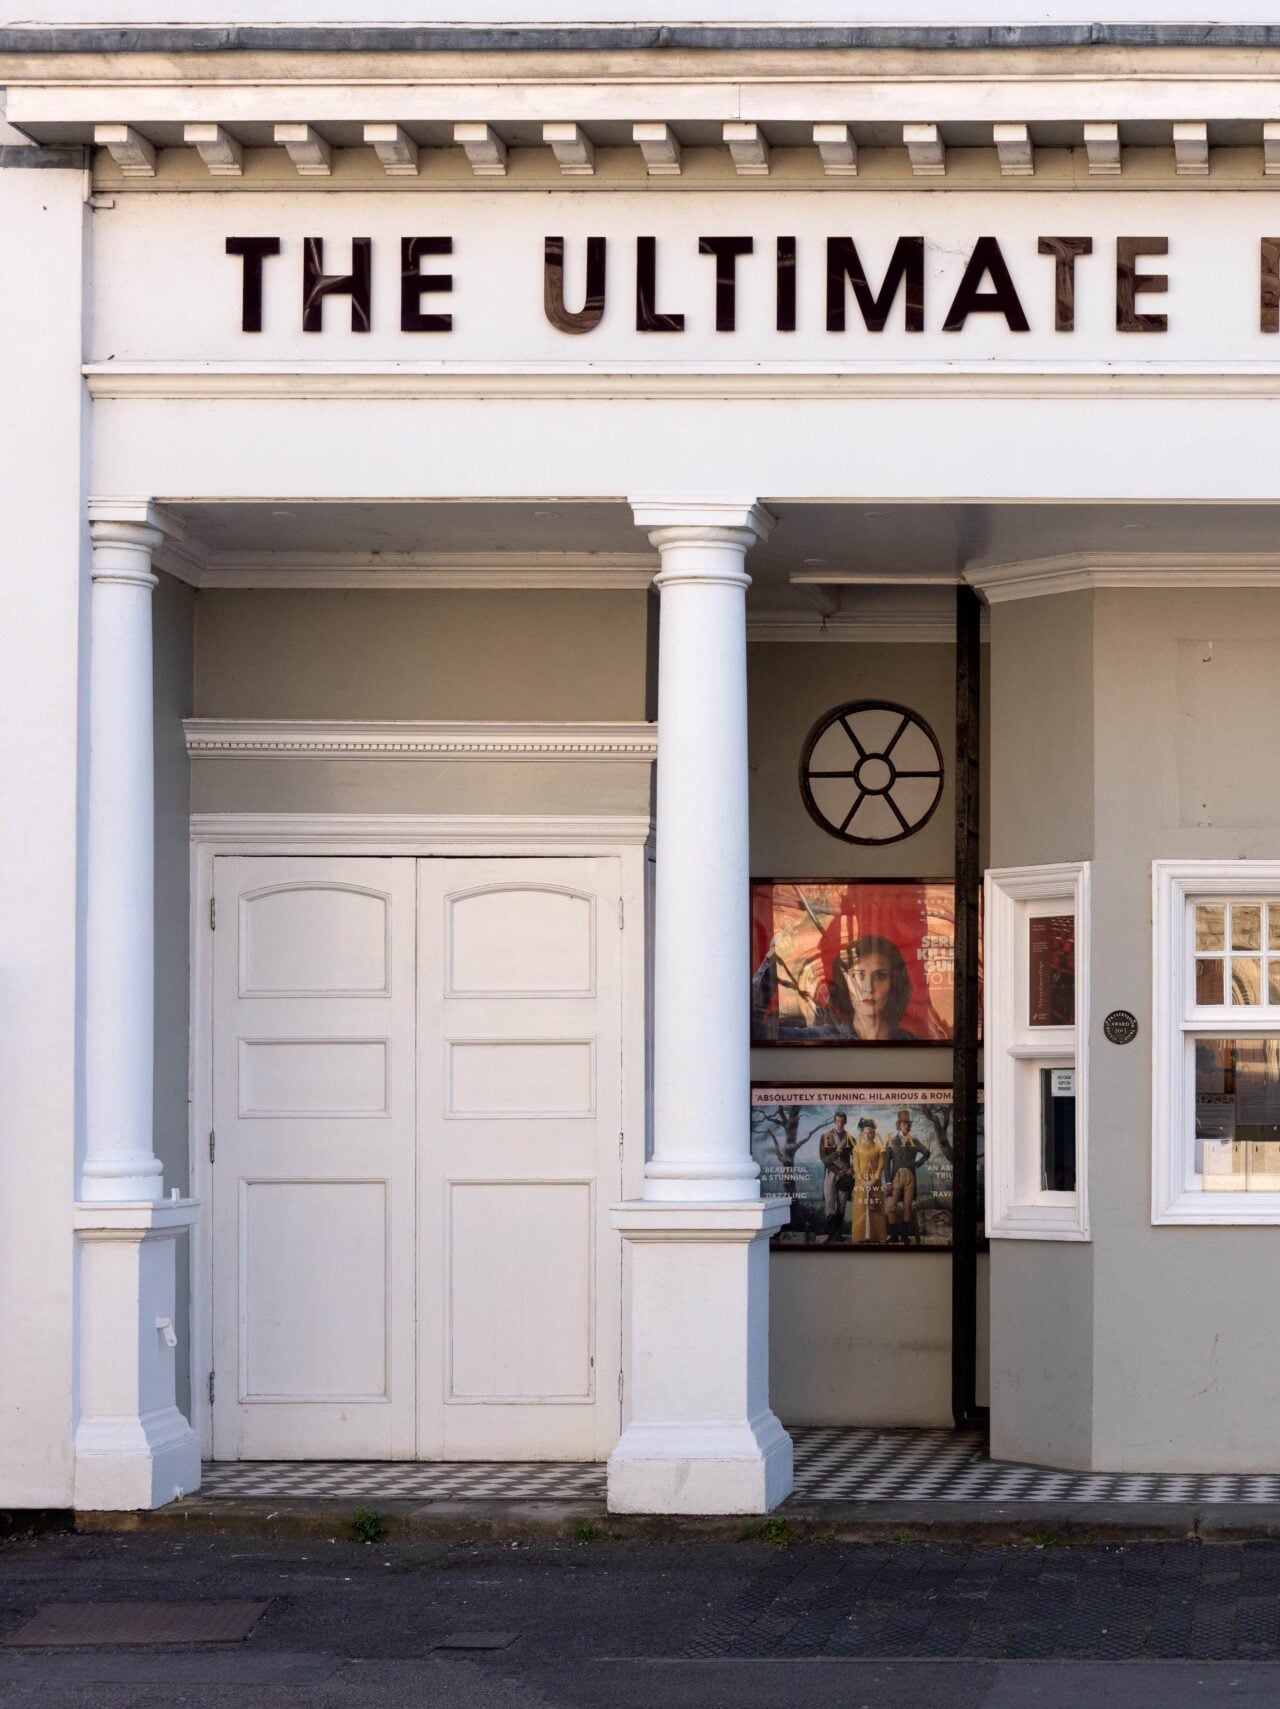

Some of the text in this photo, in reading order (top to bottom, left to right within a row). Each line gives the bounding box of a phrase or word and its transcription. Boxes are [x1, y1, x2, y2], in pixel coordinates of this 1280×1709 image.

[225, 236, 454, 334] THE
[543, 235, 1169, 336] ULTIMATE
[924, 973, 943, 985] TO
[869, 1092, 919, 1100] HILARIOUS
[920, 1092, 928, 1100] &
[930, 1092, 954, 1100] ROM
